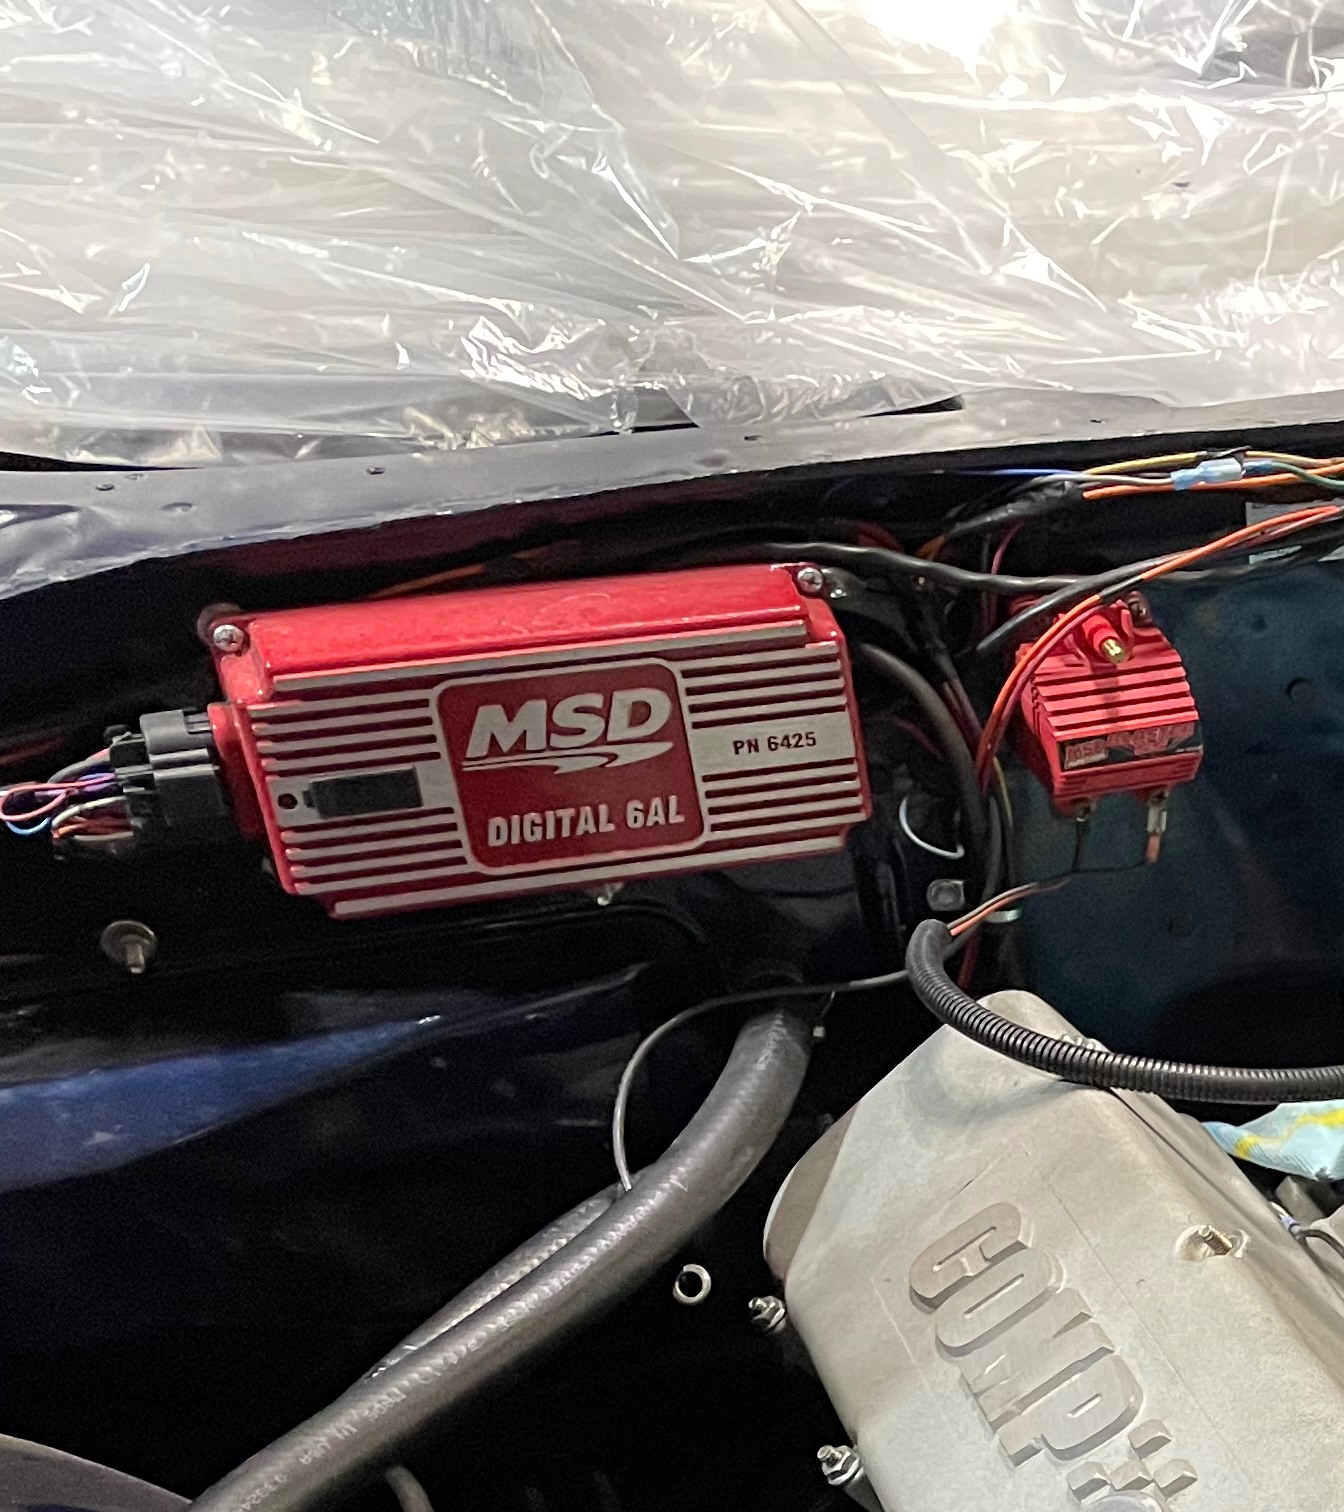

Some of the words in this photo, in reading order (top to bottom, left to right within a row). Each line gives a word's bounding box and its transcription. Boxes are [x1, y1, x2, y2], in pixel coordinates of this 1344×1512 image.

[465, 687, 673, 758] MSD
[732, 738, 760, 755] PN
[767, 731, 817, 752] 6425
[487, 804, 614, 848] DIGITAL
[626, 795, 685, 828] 6AL
[909, 1202, 1143, 1467] COMP
